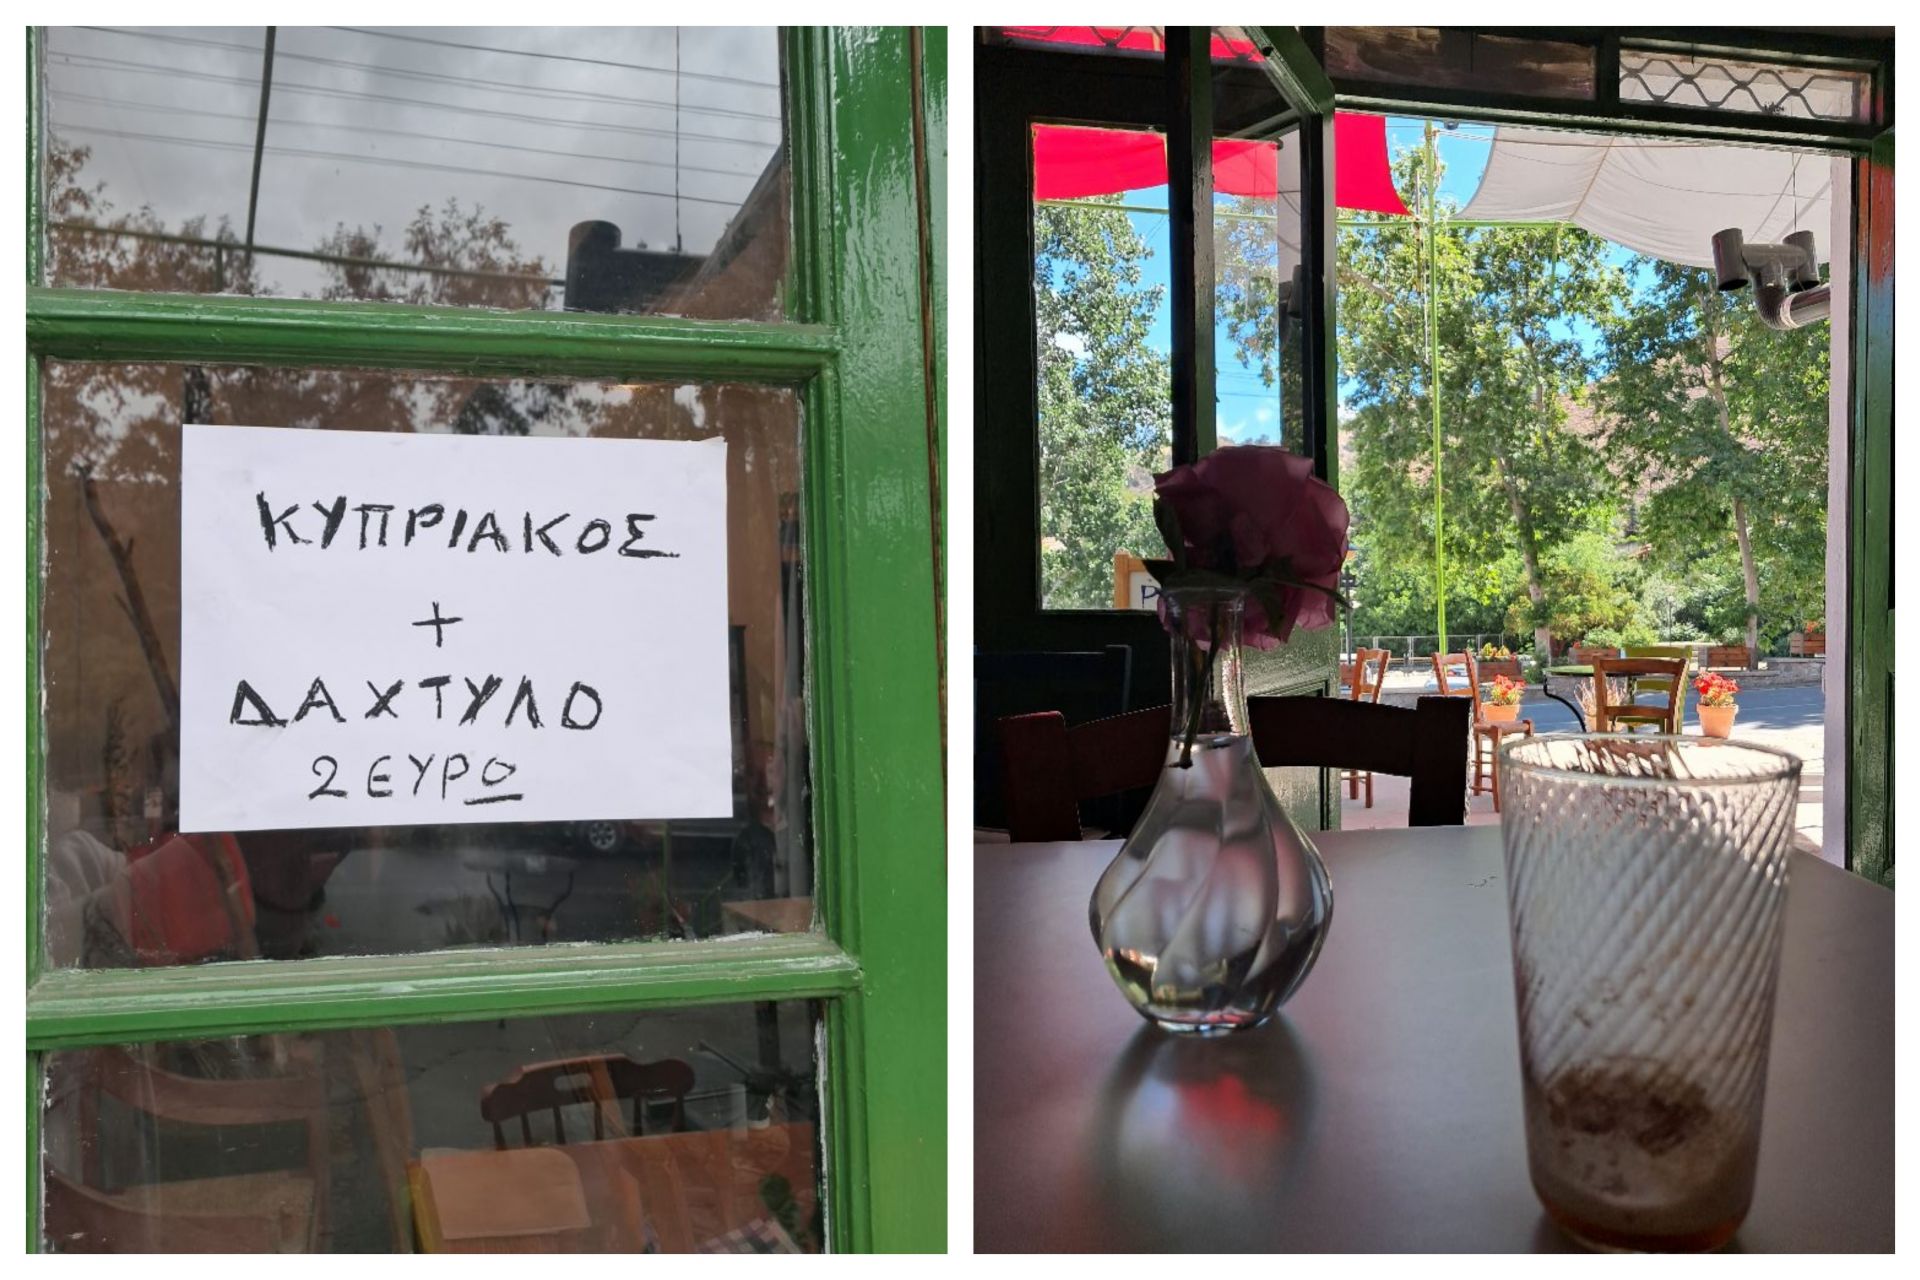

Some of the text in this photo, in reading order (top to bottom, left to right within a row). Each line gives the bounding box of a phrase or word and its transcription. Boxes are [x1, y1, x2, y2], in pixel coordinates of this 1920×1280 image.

[256, 491, 680, 559] ΚΥΠΡΙΑΚΟΣ
[412, 601, 463, 648] +
[230, 674, 603, 731] ΔΑΧΤΥΛΟ
[308, 753, 523, 806] 2 ΕΥΡΟ
